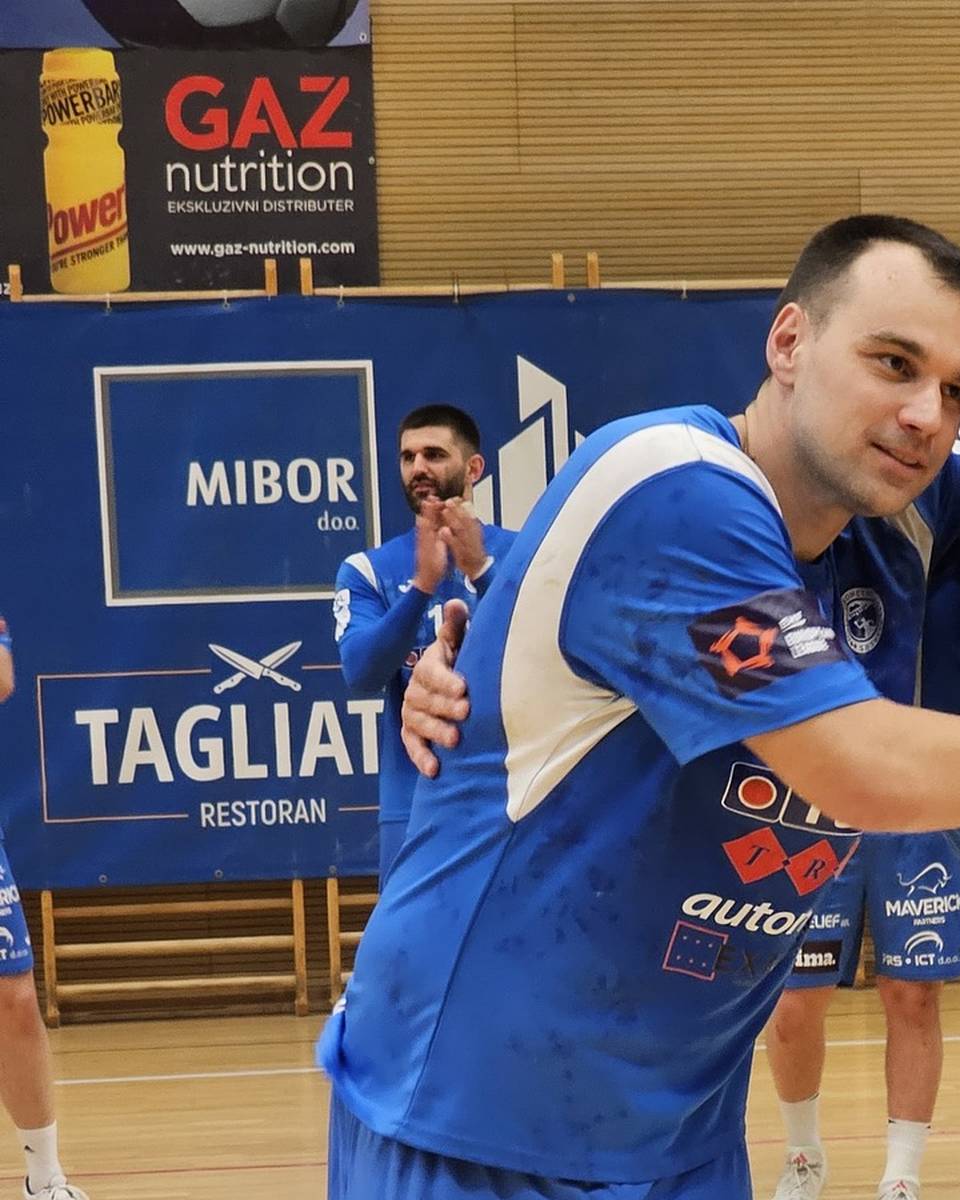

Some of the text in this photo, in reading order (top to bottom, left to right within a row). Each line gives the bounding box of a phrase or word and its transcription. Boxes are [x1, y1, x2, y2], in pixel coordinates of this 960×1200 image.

[165, 75, 353, 150] GAZ
[166, 149, 354, 193] nutrition
[167, 199, 354, 213] EKSKLUZIVNI DISTRIBUTER
[170, 240, 355, 258] www.gaz-nutrition.com
[186, 458, 358, 506] MIBOR
[75, 699, 385, 785] TAGLIAT
[200, 798, 326, 827] RESTORAN
[915, 953, 936, 966] ICT
